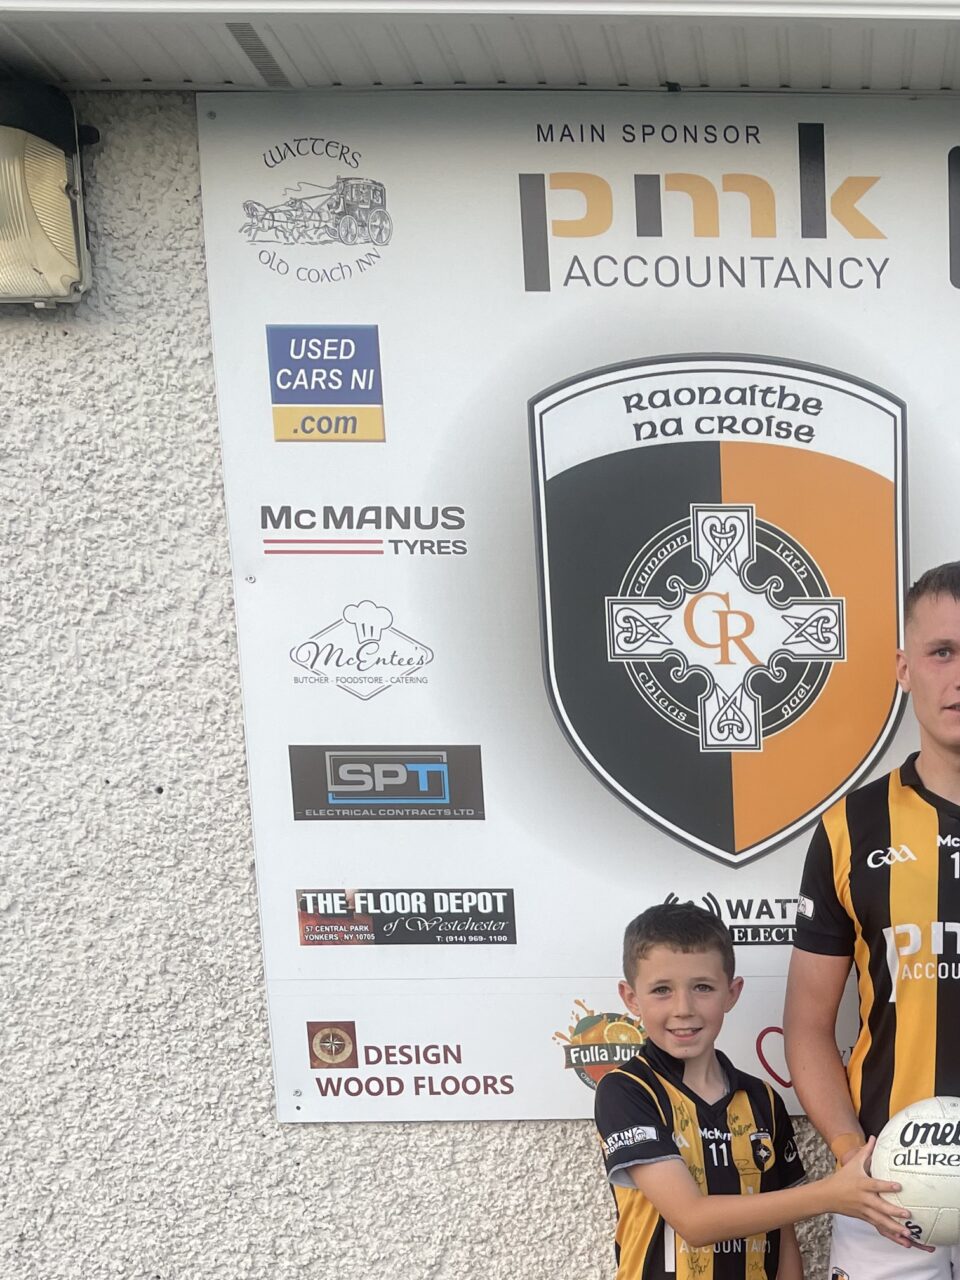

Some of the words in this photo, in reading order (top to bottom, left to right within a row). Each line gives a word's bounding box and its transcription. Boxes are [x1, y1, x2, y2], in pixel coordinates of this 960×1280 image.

[536, 124, 605, 143] MAIN
[622, 125, 761, 144] SPONSOR
[263, 137, 361, 169] WATTERS
[519, 122, 888, 292] pmk
[357, 247, 382, 273] INN
[563, 255, 890, 289] ACCOUNTANCY
[289, 339, 355, 360] USED
[275, 369, 342, 390] CARS
[350, 369, 374, 390] NI
[293, 412, 357, 434] .com
[388, 539, 467, 555] TYRES
[293, 676, 329, 684] BUTCHER
[336, 676, 383, 684] FOODSTORE
[390, 676, 428, 684] CATERING
[338, 763, 442, 792] SPT
[305, 808, 376, 816] ELECTRICAL
[378, 808, 451, 816] CONTRACTS
[453, 808, 475, 816] LTD
[302, 892, 347, 914] THE
[354, 892, 426, 914] FLOOR
[434, 892, 507, 914] DEPOT
[383, 917, 404, 937] of
[405, 916, 509, 932] Westchester
[733, 927, 797, 942] ELECT
[364, 1045, 462, 1065] DESIGN
[570, 1046, 608, 1064] Fulla
[315, 1076, 404, 1097] WOOD
[414, 1075, 514, 1096] FLOORS
[602, 1128, 633, 1149] ARTIN
[709, 1142, 729, 1167] 11
